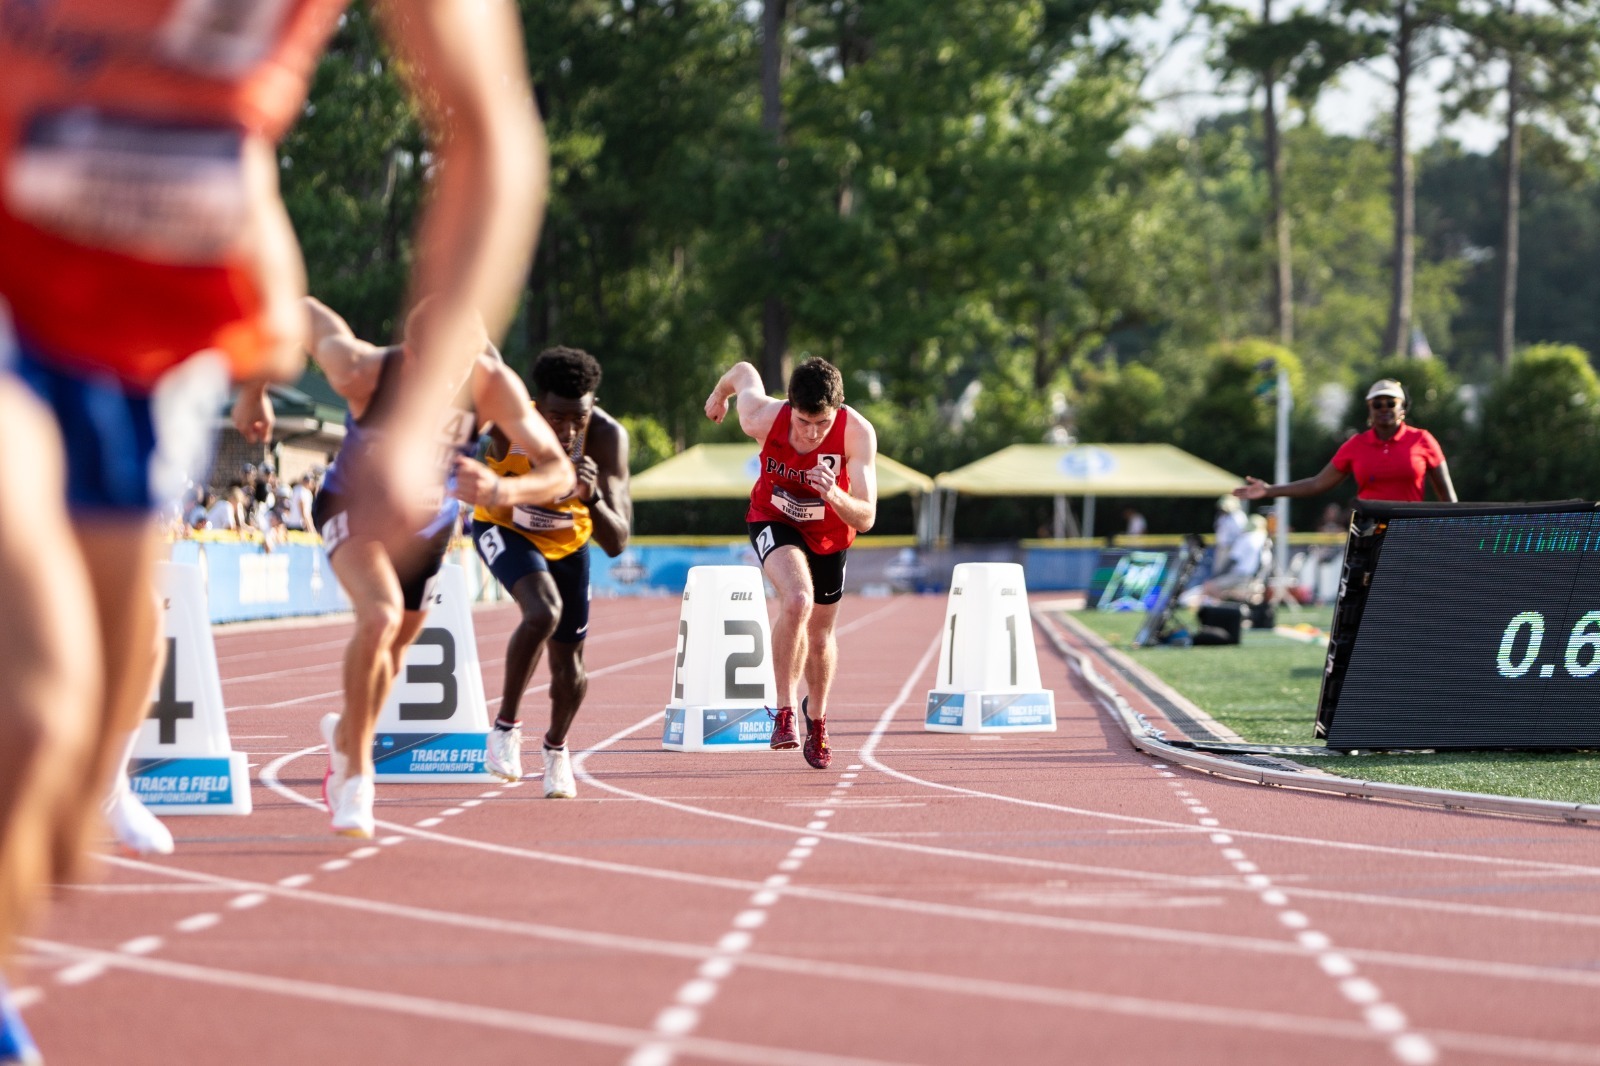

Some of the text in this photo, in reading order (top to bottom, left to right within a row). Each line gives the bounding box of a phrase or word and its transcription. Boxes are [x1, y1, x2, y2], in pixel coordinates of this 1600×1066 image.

[782, 504, 813, 518] TIERNEY
[787, 502, 808, 512] HENRY
[482, 531, 498, 559] 3
[759, 531, 771, 554] 2
[731, 592, 753, 601] GILL
[1001, 588, 1017, 596] GILL
[1005, 614, 1018, 686] 1
[1496, 610, 1600, 677] 0.6
[724, 620, 765, 699] 2
[399, 627, 458, 720] 3
[146, 637, 193, 744] 4
[739, 722, 765, 732] TRACK
[765, 722, 771, 732] &
[411, 749, 450, 762] TRACK
[450, 749, 459, 762] &
[409, 763, 475, 772] CHAMPIONSHIPS
[133, 776, 229, 792] TRACK & FIELD
[137, 791, 208, 802] AMPIONSHIPS
